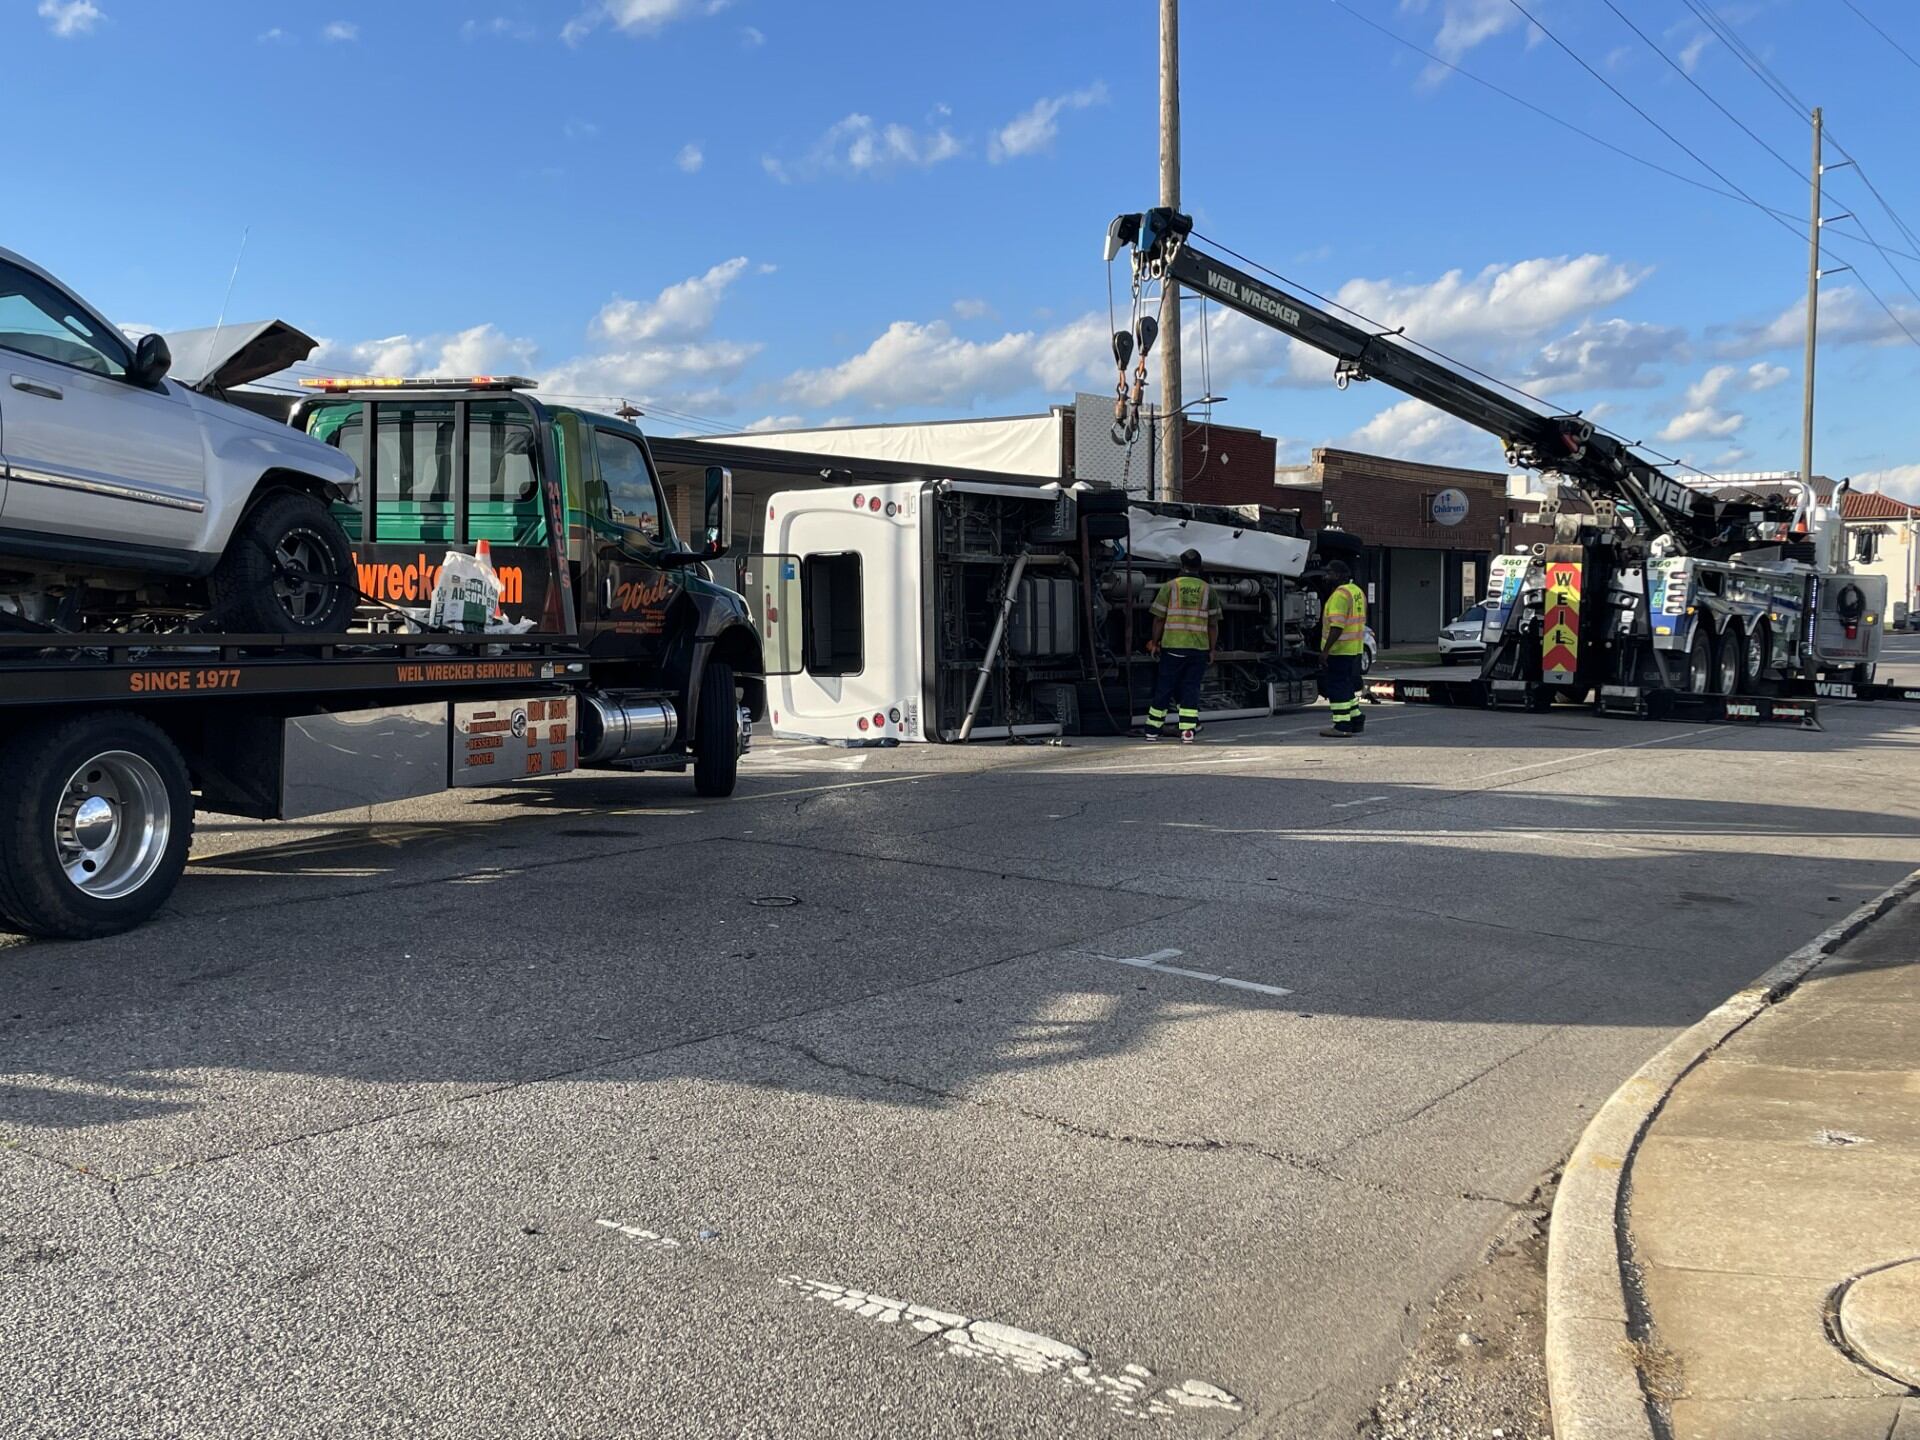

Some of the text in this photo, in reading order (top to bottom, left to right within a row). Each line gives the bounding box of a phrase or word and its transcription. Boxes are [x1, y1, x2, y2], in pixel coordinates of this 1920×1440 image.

[1208, 269, 1300, 327] WEIL WRECKER
[1649, 471, 1695, 518] WEIL
[1433, 503, 1465, 514] Children's
[547, 481, 571, 588] 24 HOURS
[617, 574, 666, 613] Weil
[1555, 571, 1573, 645] WEIL
[129, 669, 241, 692] SINCE 1977
[397, 665, 424, 682] WEIL
[425, 664, 474, 680] WRECKER
[475, 663, 516, 679] SERVICE
[517, 663, 535, 678] INC.
[1403, 686, 1430, 698] WEIL
[1815, 682, 1857, 698] WEIL
[1726, 704, 1760, 717] WEIL
